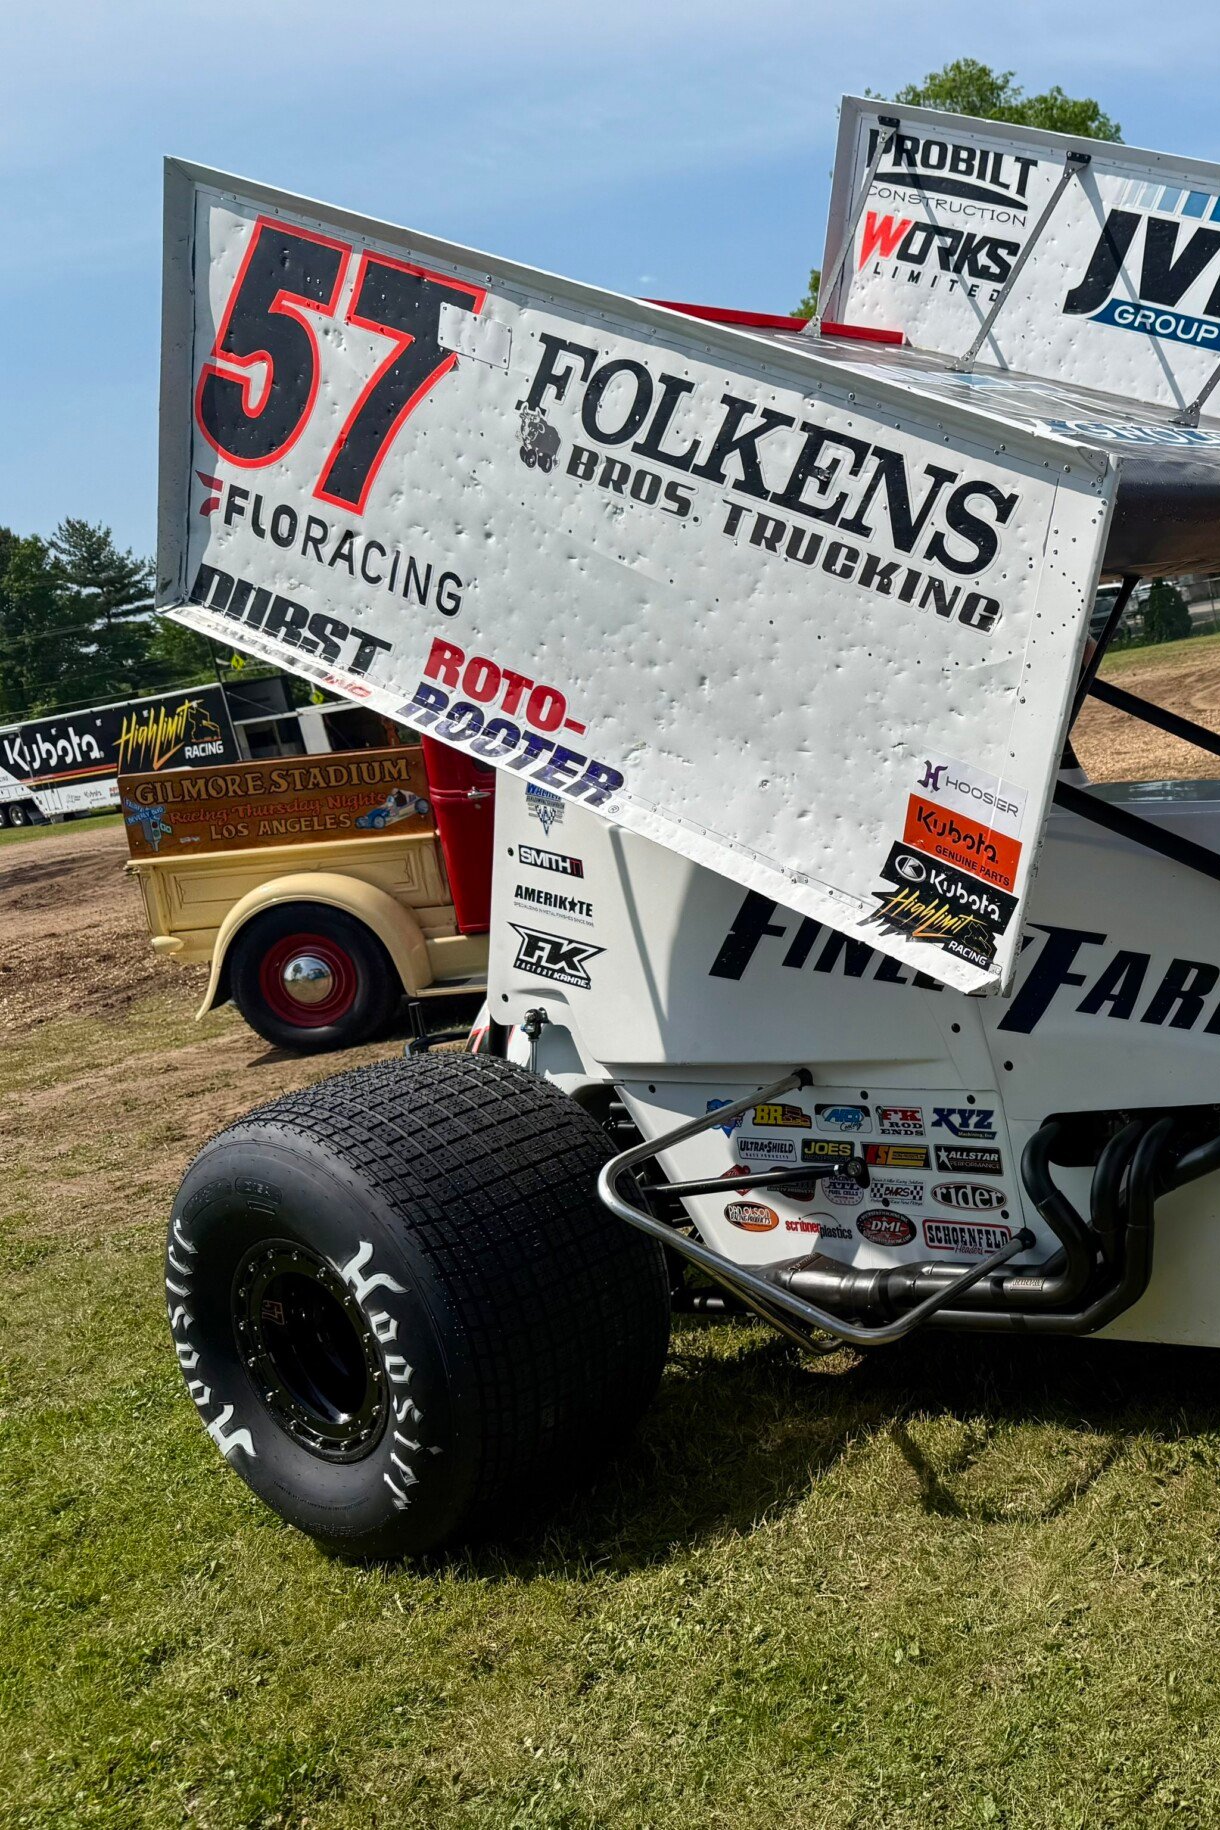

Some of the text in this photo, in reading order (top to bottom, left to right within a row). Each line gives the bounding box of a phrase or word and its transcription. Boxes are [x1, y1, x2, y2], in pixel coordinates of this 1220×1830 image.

[866, 129, 1038, 198] PROBILT
[867, 185, 1027, 228] CONSTRUCTION
[858, 211, 1020, 284] WORKS
[873, 262, 1000, 302] LIMITED
[1113, 305, 1220, 343] GROUP
[195, 214, 487, 516] 57
[515, 333, 1019, 577] FOLKENS
[223, 484, 464, 617] FLORACING
[567, 444, 1002, 633] BROS. TRUCKING
[424, 636, 587, 736] ROTO-
[3, 727, 102, 771] Kubota
[184, 740, 224, 759] RACING
[396, 681, 625, 808] ROOTER
[135, 758, 410, 805] GILMORE STADIUM
[945, 776, 1019, 817] HOOSIER
[168, 792, 388, 825] Racing Thursday Nights
[211, 822, 249, 841] LOS
[258, 813, 351, 836] ANGELES
[917, 805, 998, 864] Kubota
[935, 844, 1010, 887] GENUINE PARTS
[930, 869, 1001, 921] Kubota
[948, 940, 987, 967] RACING
[516, 960, 588, 988] FACTORY KAHNE
[755, 1104, 783, 1125] BR
[880, 1128, 924, 1137] ENDS
[882, 1109, 921, 1122] FK
[889, 1121, 923, 1129] ROD
[931, 1107, 995, 1130] XYZ
[804, 1142, 852, 1156] JOES
[949, 1151, 998, 1161] ALLSTAR
[935, 1185, 1002, 1208] rider
[871, 1220, 901, 1232] DMI
[927, 1224, 1009, 1249] SCHOENFELD
